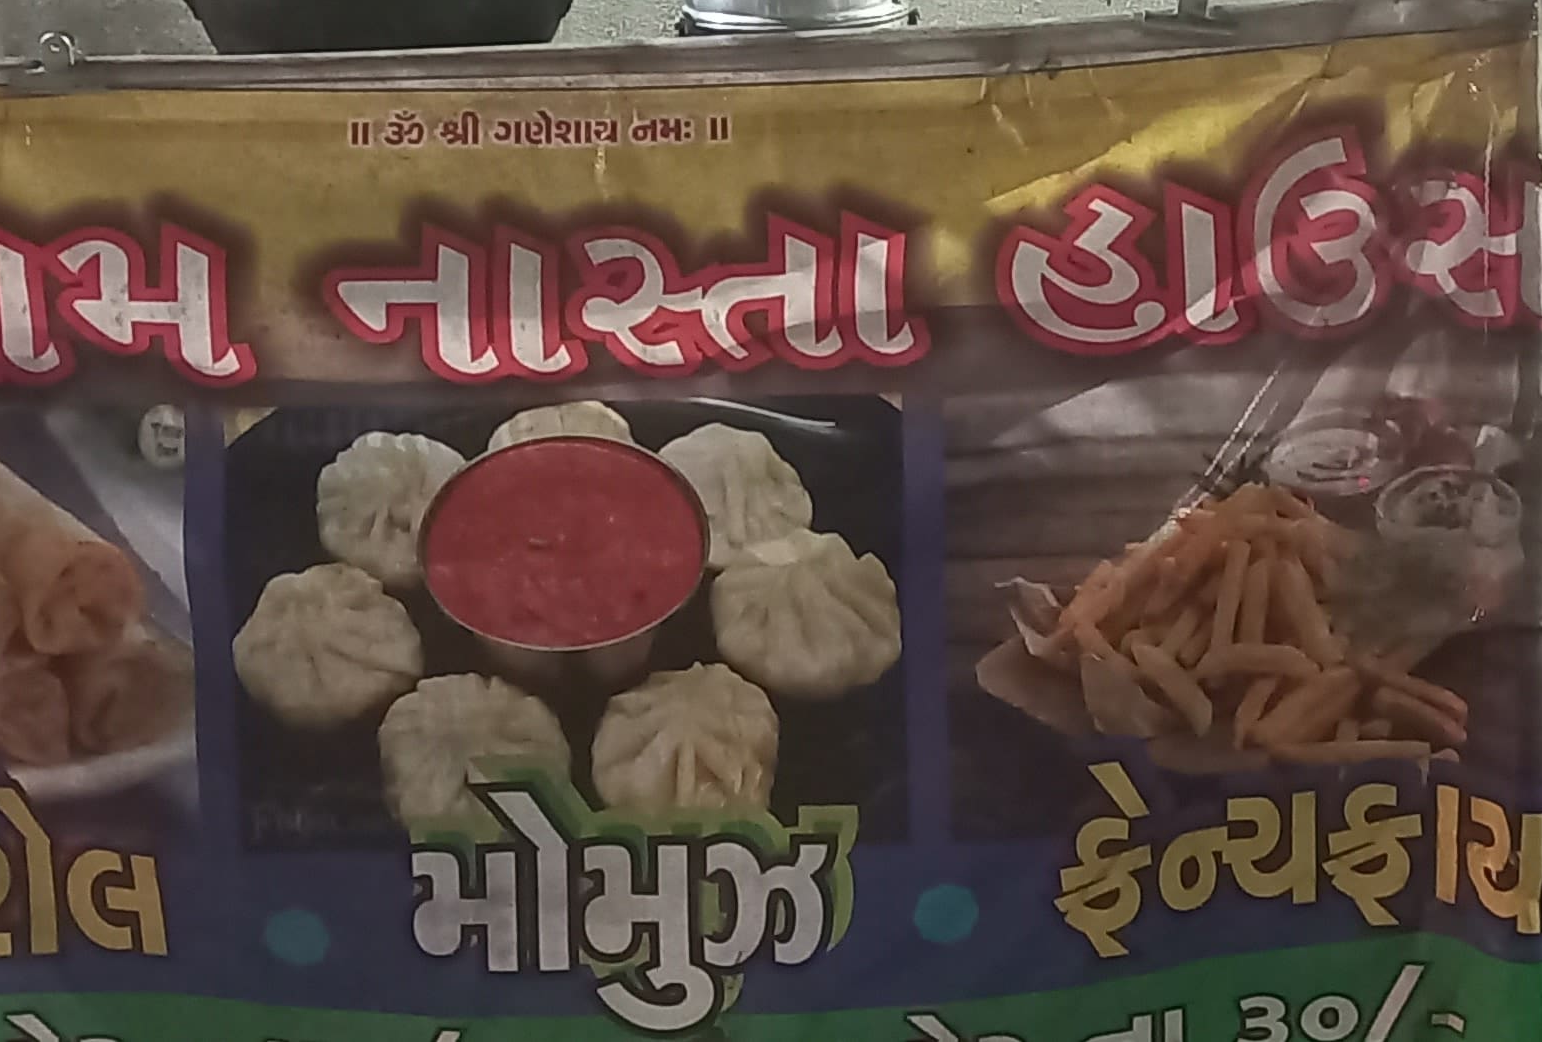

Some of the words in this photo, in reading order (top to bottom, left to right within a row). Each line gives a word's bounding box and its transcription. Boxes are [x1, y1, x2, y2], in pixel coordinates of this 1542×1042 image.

[439, 109, 482, 147] શ્રી
[492, 109, 619, 147] ગણેશાય
[331, 226, 921, 378] નાસ્તા
[409, 788, 833, 1034] મોમુઝ
